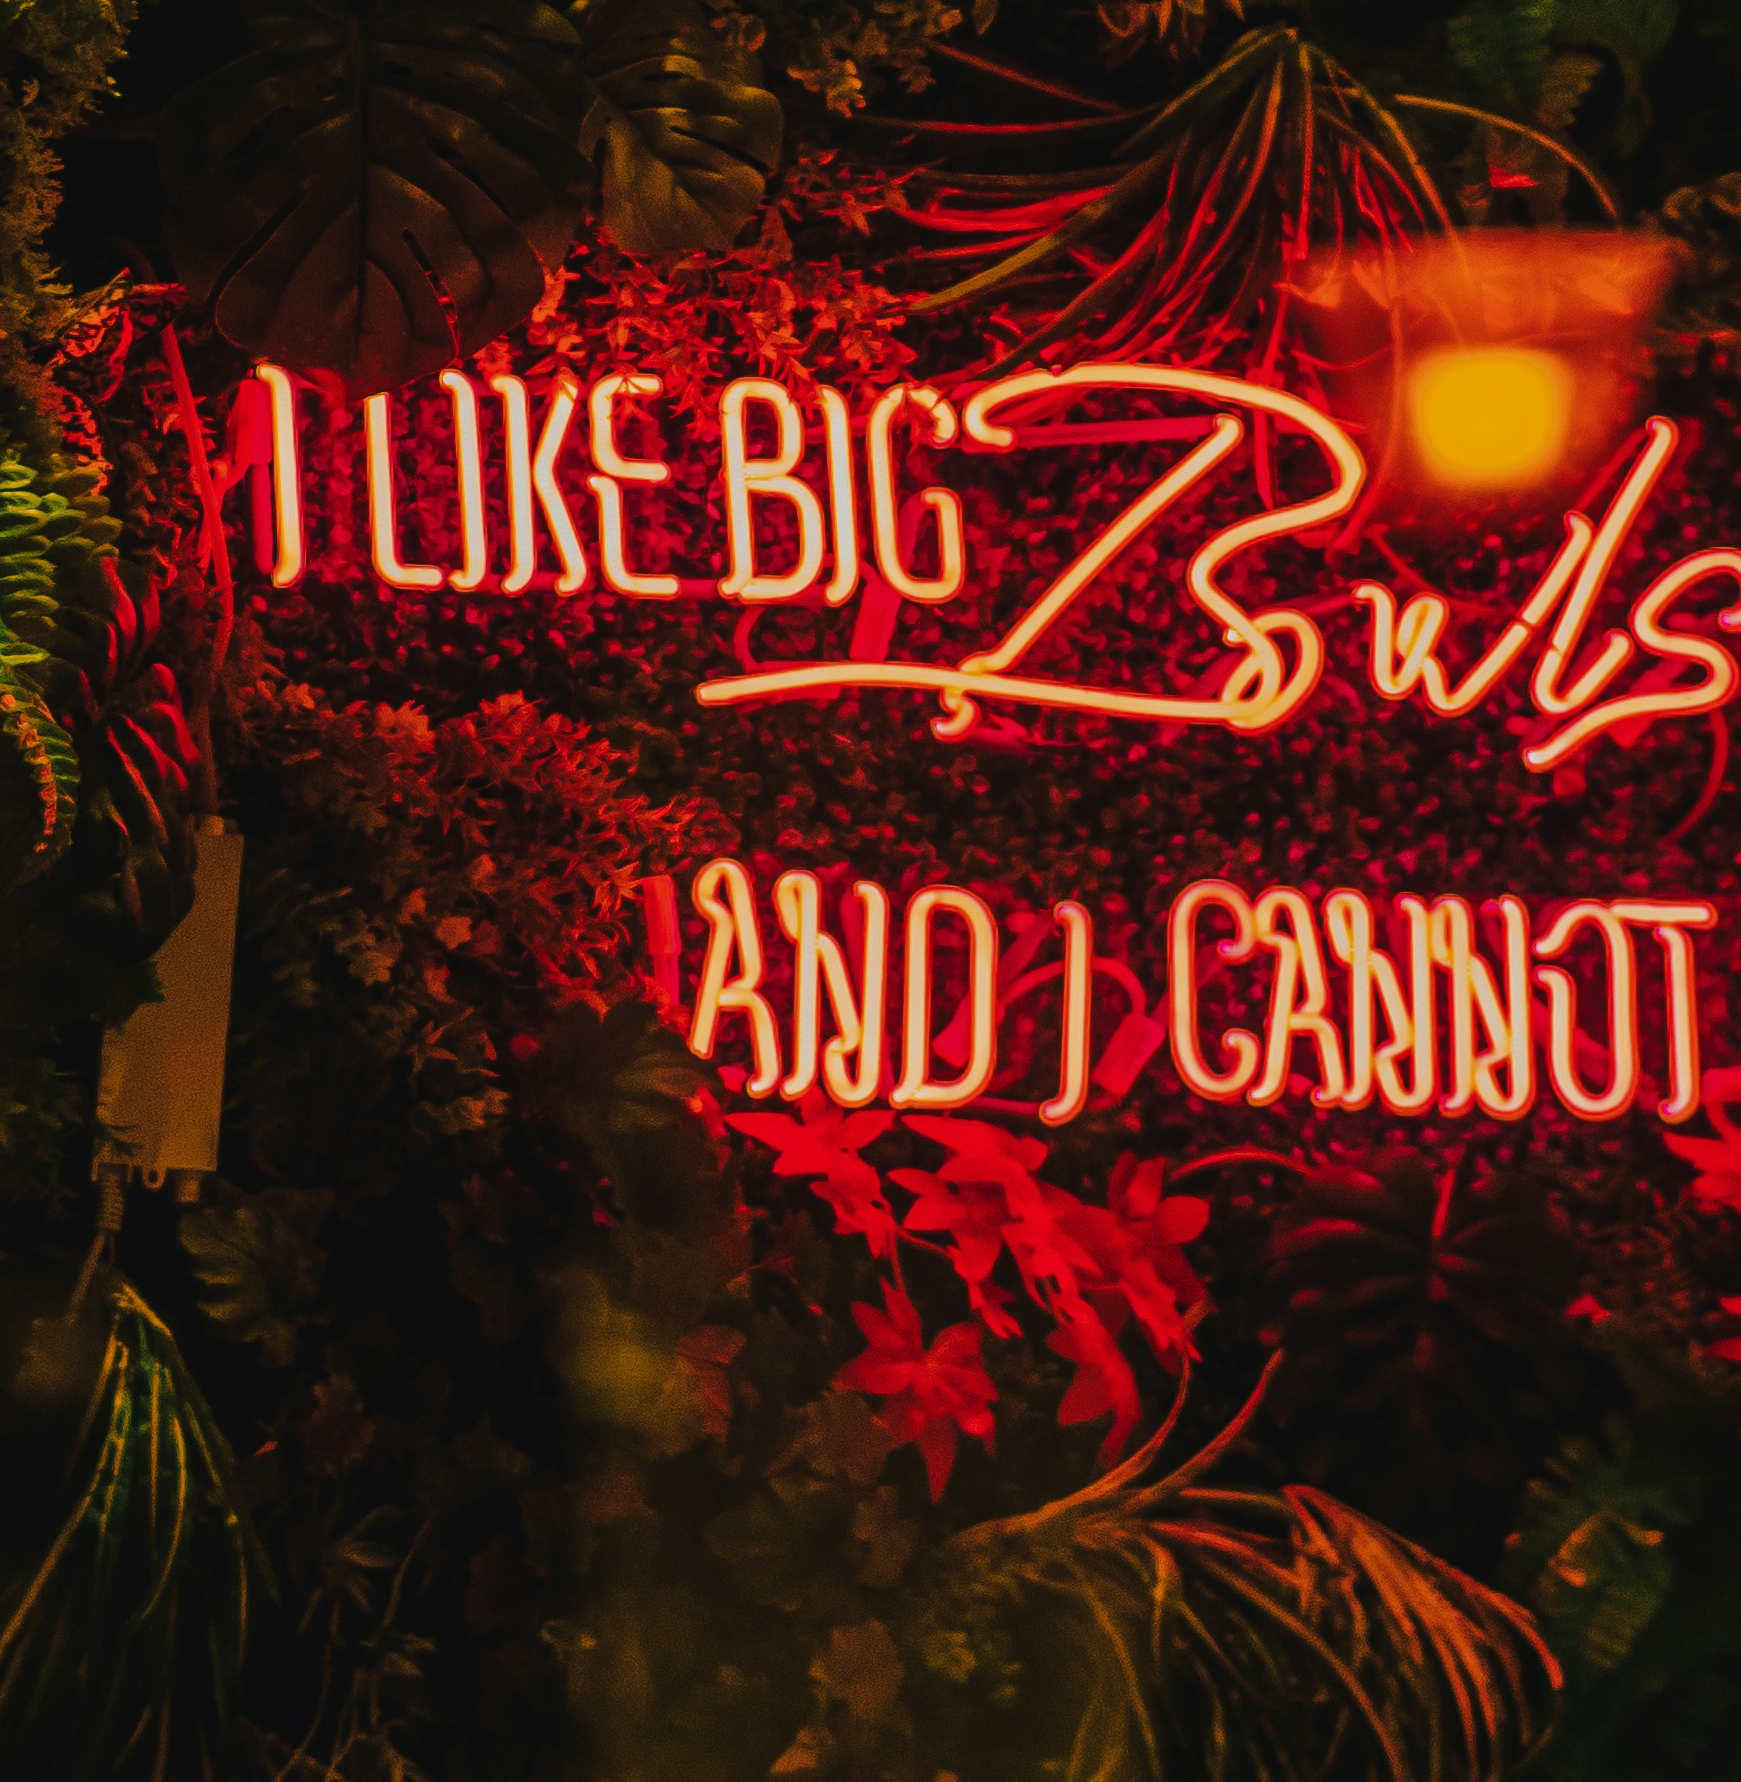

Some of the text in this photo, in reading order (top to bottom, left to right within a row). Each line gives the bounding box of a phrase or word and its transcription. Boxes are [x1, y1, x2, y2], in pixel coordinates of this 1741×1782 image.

[255, 362, 306, 589] I
[362, 366, 681, 600] LIKE
[716, 376, 966, 604] BIG
[688, 857, 999, 1108] AND
[1167, 880, 1716, 1120] CANNOT
